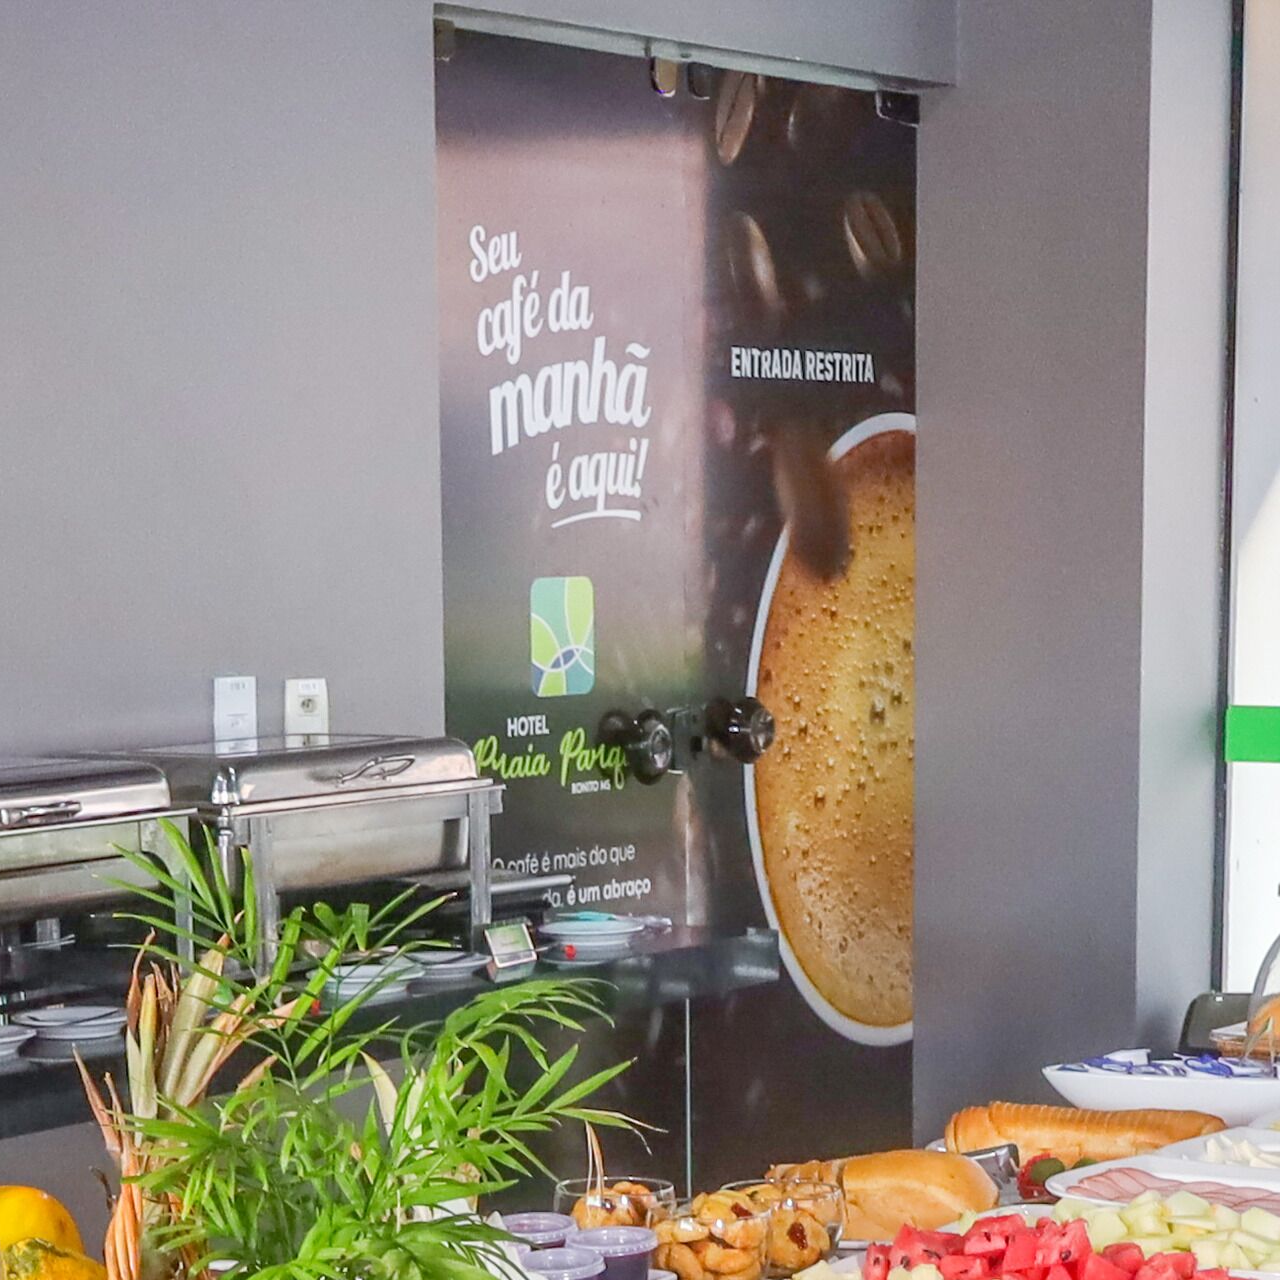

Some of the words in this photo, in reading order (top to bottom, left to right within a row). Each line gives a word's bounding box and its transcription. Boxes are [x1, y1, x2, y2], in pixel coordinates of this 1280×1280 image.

[468, 225, 522, 283] Seu
[477, 270, 544, 366] café
[547, 270, 595, 334] da
[730, 346, 803, 381] ENTRADA
[804, 350, 875, 384] RESTRITA
[489, 335, 653, 456] manhã
[545, 440, 567, 510] é
[568, 436, 650, 513] aqui!
[506, 714, 550, 738] HOTEL
[473, 735, 551, 780] Praia
[559, 727, 629, 791] Parq
[571, 781, 599, 795] BONITO
[507, 852, 539, 875] café
[541, 851, 550, 873] é
[553, 846, 588, 871] mais
[588, 844, 607, 866] do
[608, 843, 636, 867] que
[566, 884, 577, 906] é
[578, 888, 601, 904] um
[602, 877, 652, 900] abraço
